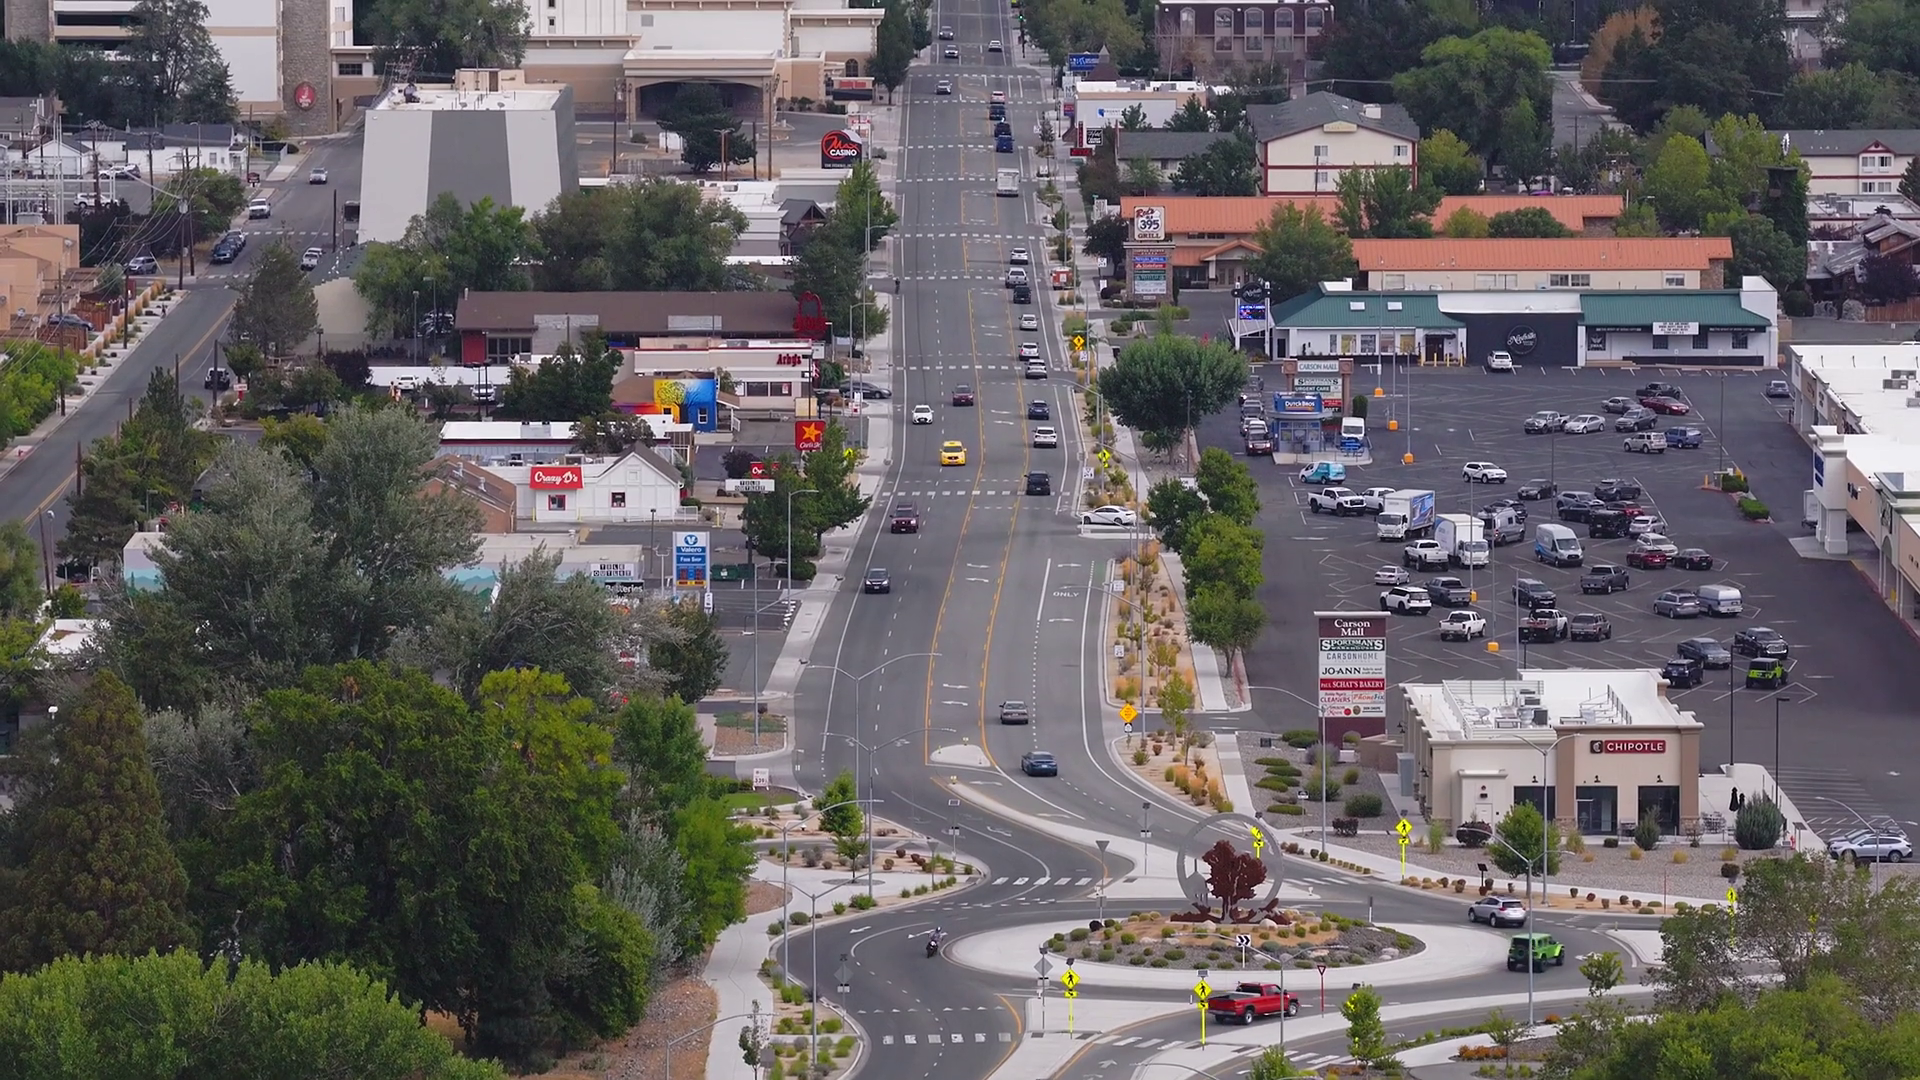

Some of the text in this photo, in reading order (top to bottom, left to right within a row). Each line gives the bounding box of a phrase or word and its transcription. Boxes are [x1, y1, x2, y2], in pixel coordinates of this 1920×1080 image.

[829, 149, 858, 157] CASINO
[1140, 219, 1160, 230] 395
[776, 354, 802, 367] Arby's
[534, 471, 578, 485] Crazy D's
[1334, 619, 1371, 628] Carson
[1341, 628, 1365, 636] Mall
[1321, 639, 1384, 651] SPORTSMAN'S
[1332, 681, 1359, 689] SCHAT'S
[1606, 742, 1664, 751] CHIPOTLE
